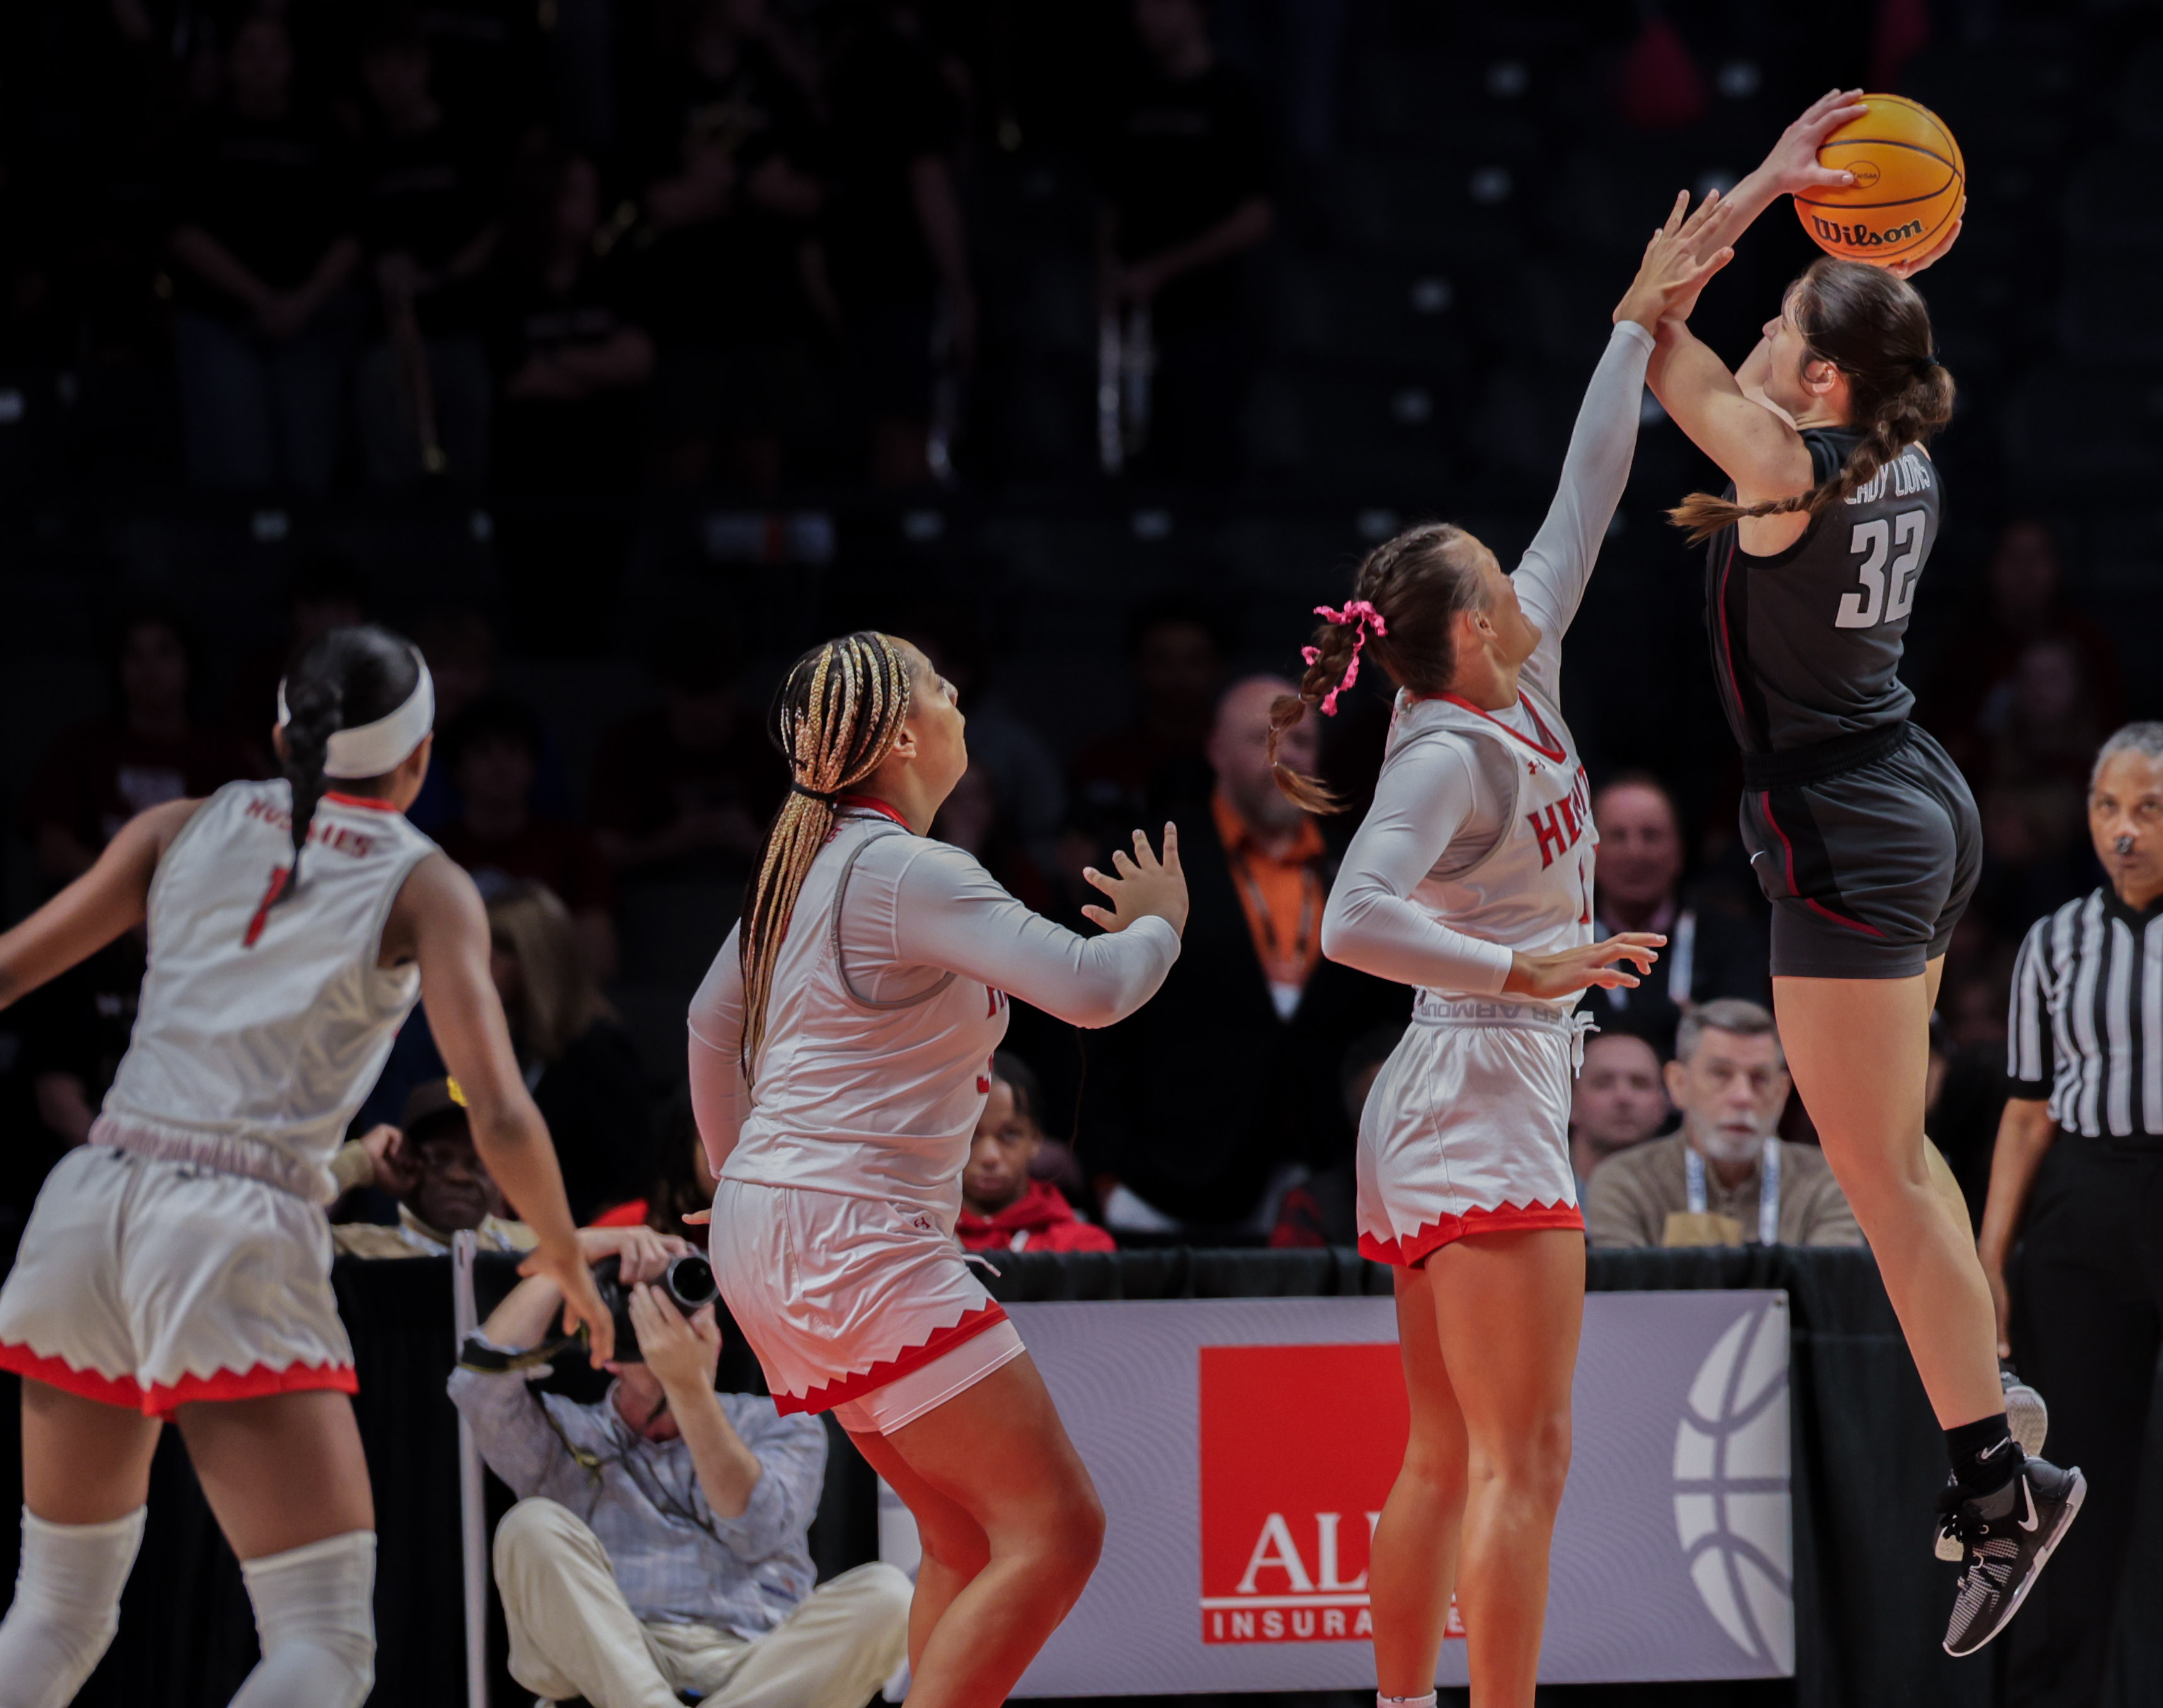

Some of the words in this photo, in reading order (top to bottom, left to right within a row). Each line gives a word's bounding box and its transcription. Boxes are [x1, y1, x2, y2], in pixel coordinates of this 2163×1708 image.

[1812, 215, 1922, 246] Wilson
[1892, 453, 1931, 497] LIONS
[1835, 510, 1926, 628] 32
[1421, 1003, 1522, 1019] ARMOUR
[1235, 1512, 1383, 1593] AL
[1213, 1607, 1466, 1639] INSURAE
